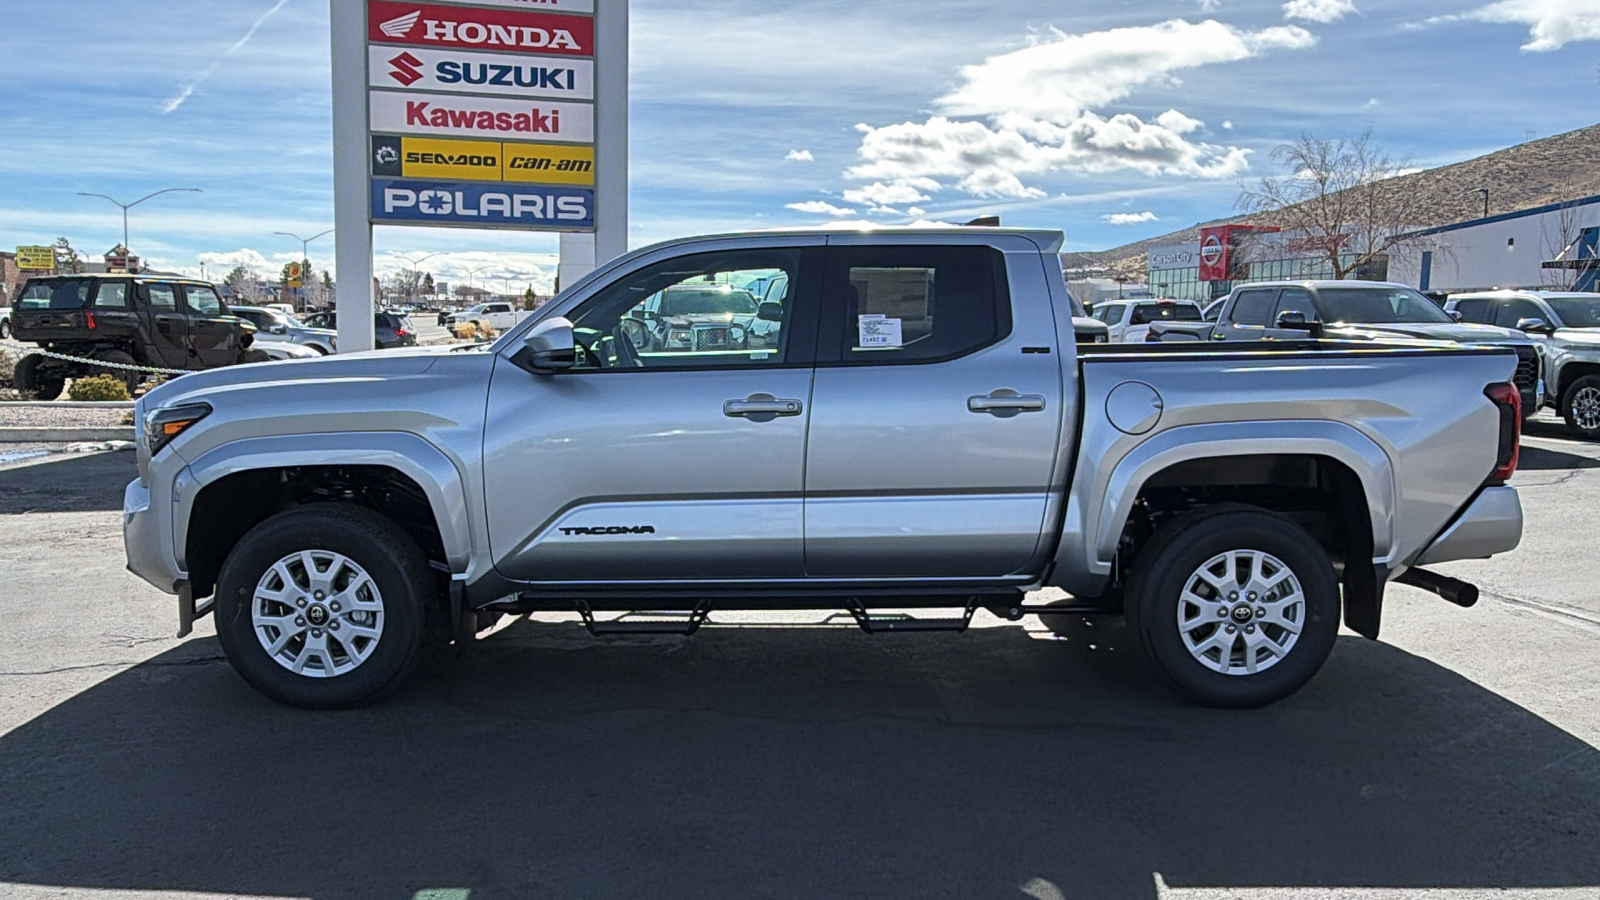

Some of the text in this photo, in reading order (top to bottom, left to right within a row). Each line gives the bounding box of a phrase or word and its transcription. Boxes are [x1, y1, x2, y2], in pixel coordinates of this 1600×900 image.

[423, 19, 581, 50] HONDA
[435, 61, 575, 90] SUZUKI
[406, 101, 560, 134] Kawasaki
[509, 156, 592, 172] can-am
[384, 188, 587, 221] POLARIS
[1151, 251, 1193, 264] Carson City
[558, 525, 655, 536] TACOMA
